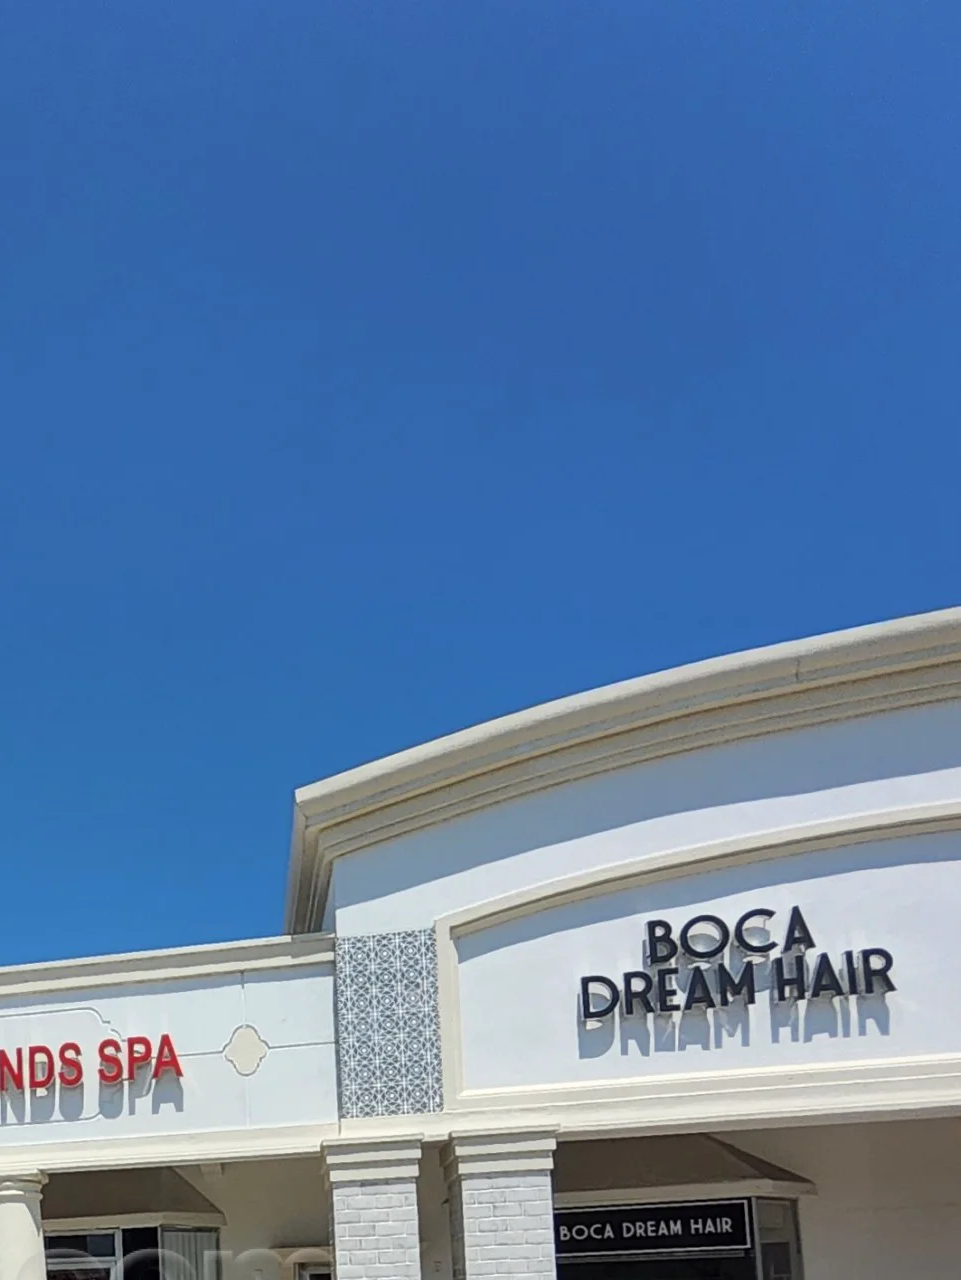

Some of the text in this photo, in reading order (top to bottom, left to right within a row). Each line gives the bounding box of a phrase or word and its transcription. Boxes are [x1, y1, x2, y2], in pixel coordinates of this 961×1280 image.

[645, 905, 817, 966] BOCA
[580, 947, 898, 1020] DREAM HAIR
[97, 1033, 185, 1085] SPA
[559, 1217, 734, 1241] BOCA DREAM HAIR
